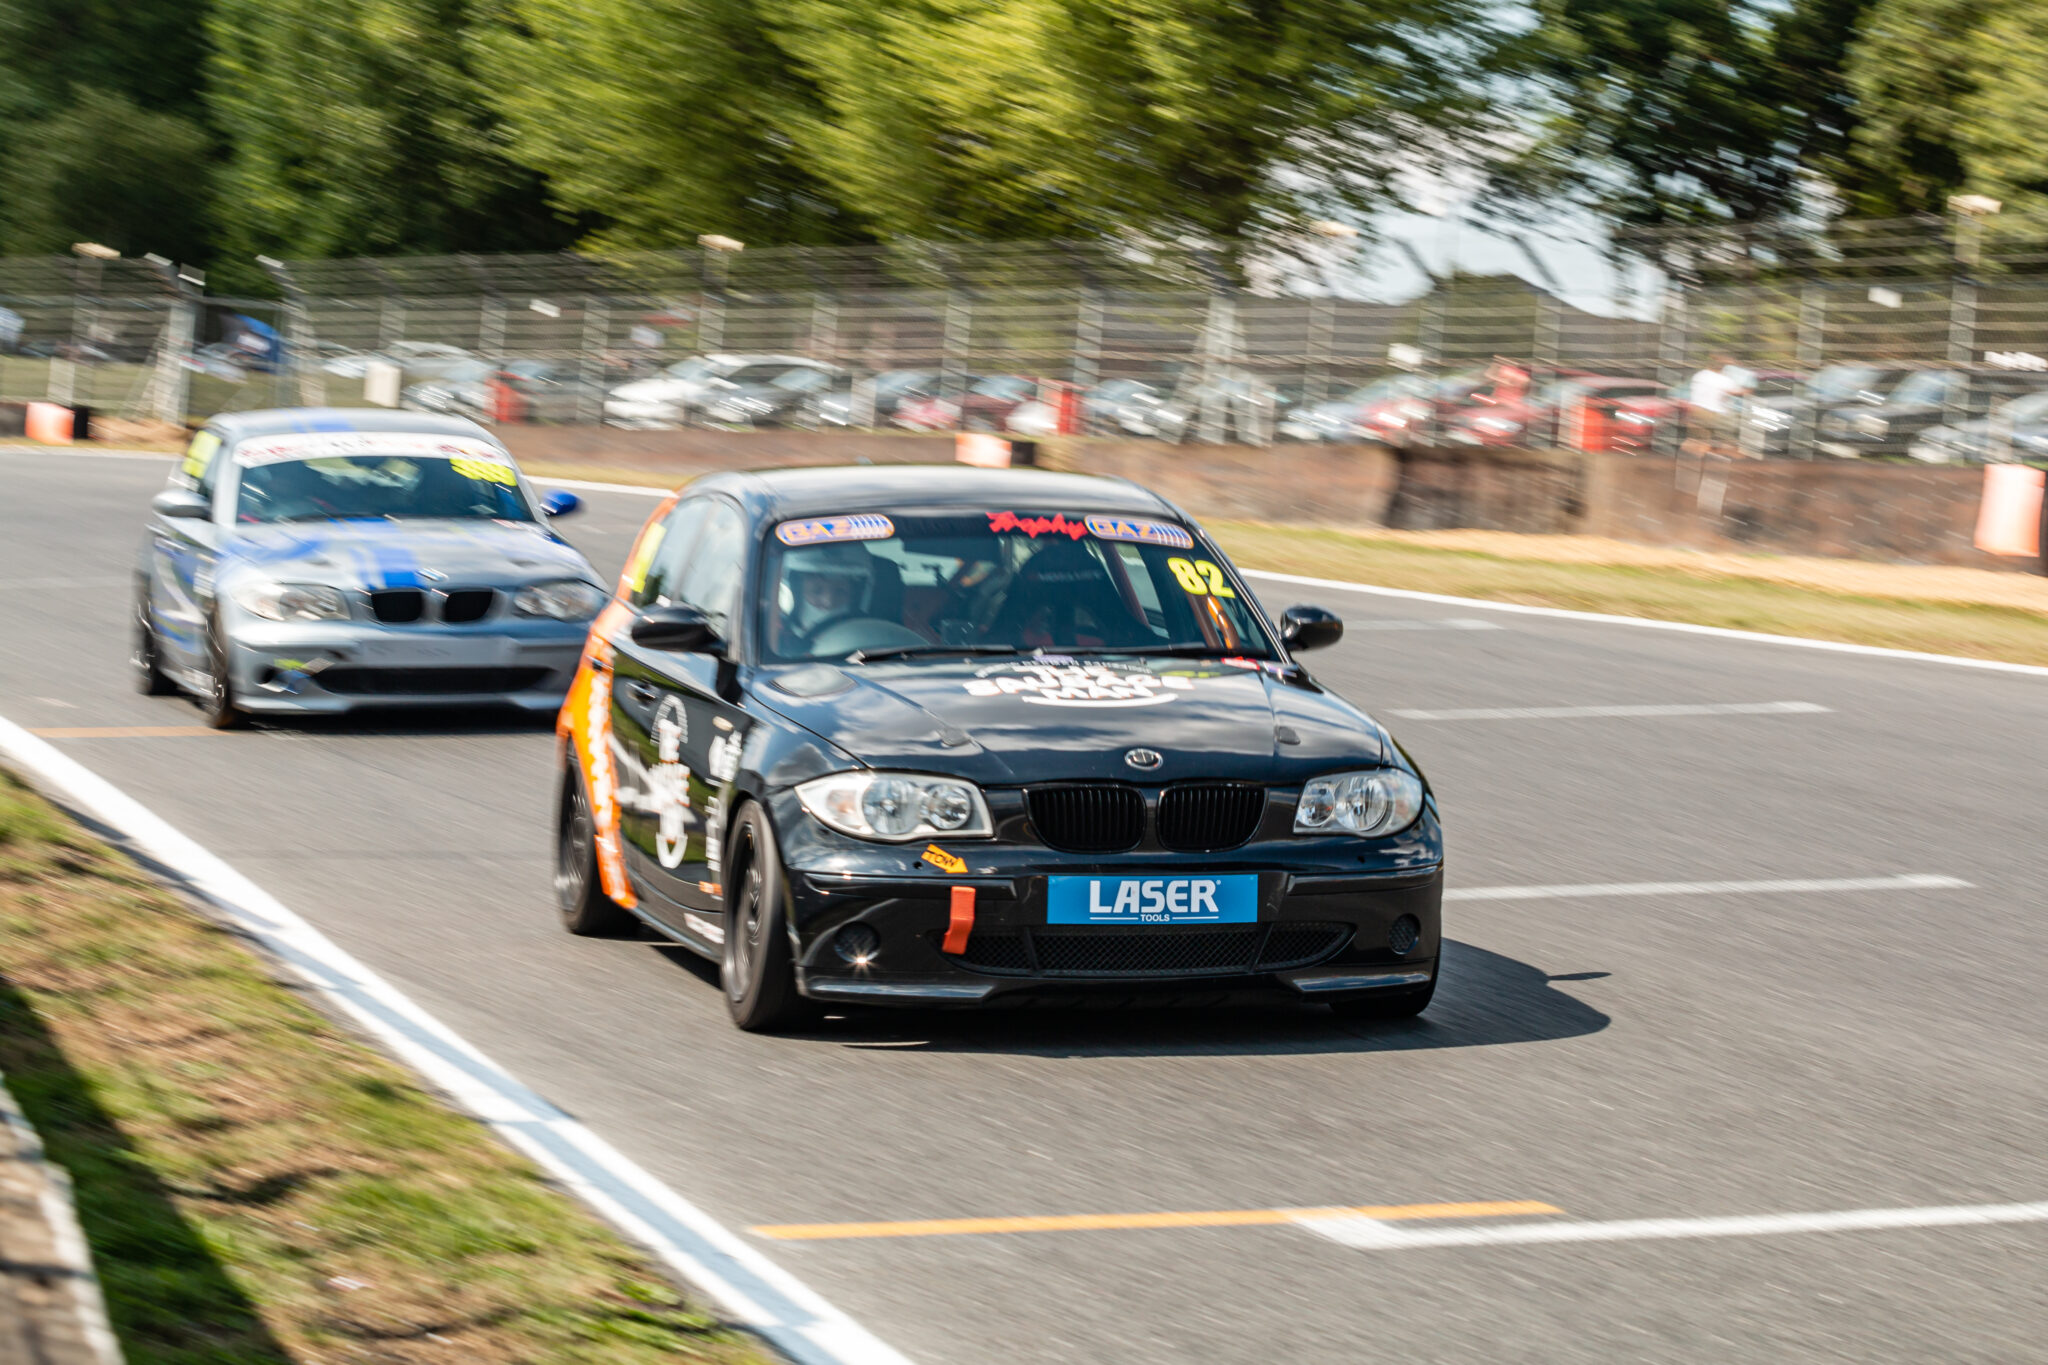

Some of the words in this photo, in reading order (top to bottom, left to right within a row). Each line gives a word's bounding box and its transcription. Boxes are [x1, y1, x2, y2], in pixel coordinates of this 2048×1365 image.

[1167, 557, 1236, 599] 82
[1090, 880, 1219, 913] LASER
[1140, 914, 1170, 922] TOOLS
